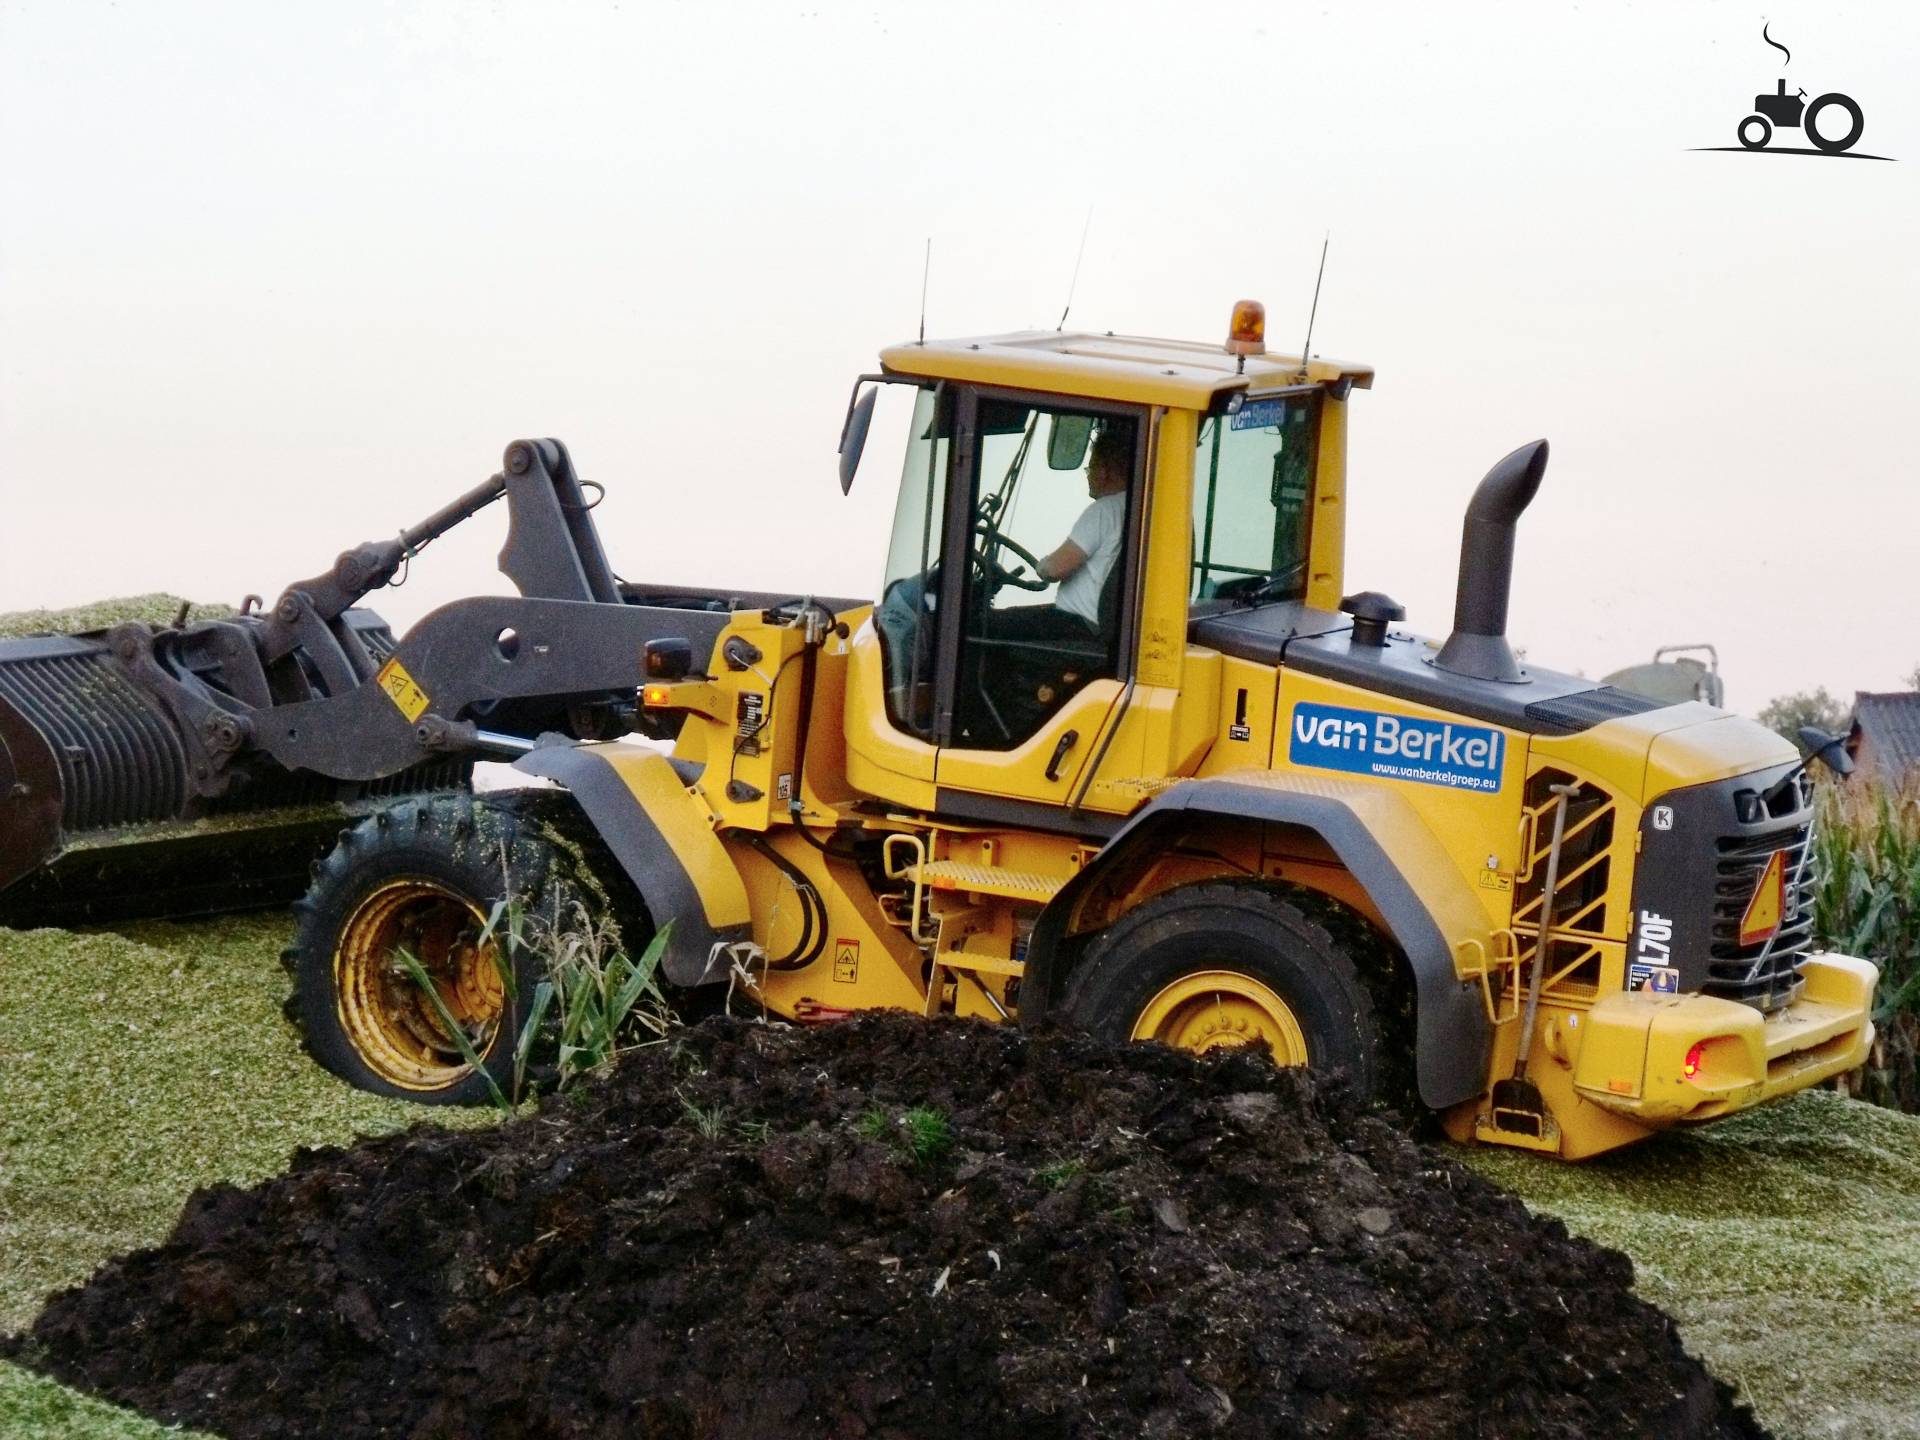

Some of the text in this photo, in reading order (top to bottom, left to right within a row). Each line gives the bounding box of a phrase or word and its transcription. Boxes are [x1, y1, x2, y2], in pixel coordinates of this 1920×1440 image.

[1252, 402, 1285, 424] Berkel
[1296, 714, 1499, 770] van Berkel
[1372, 762, 1497, 789] www.vanberkelgroep.eu
[1637, 910, 1673, 967] L70F
